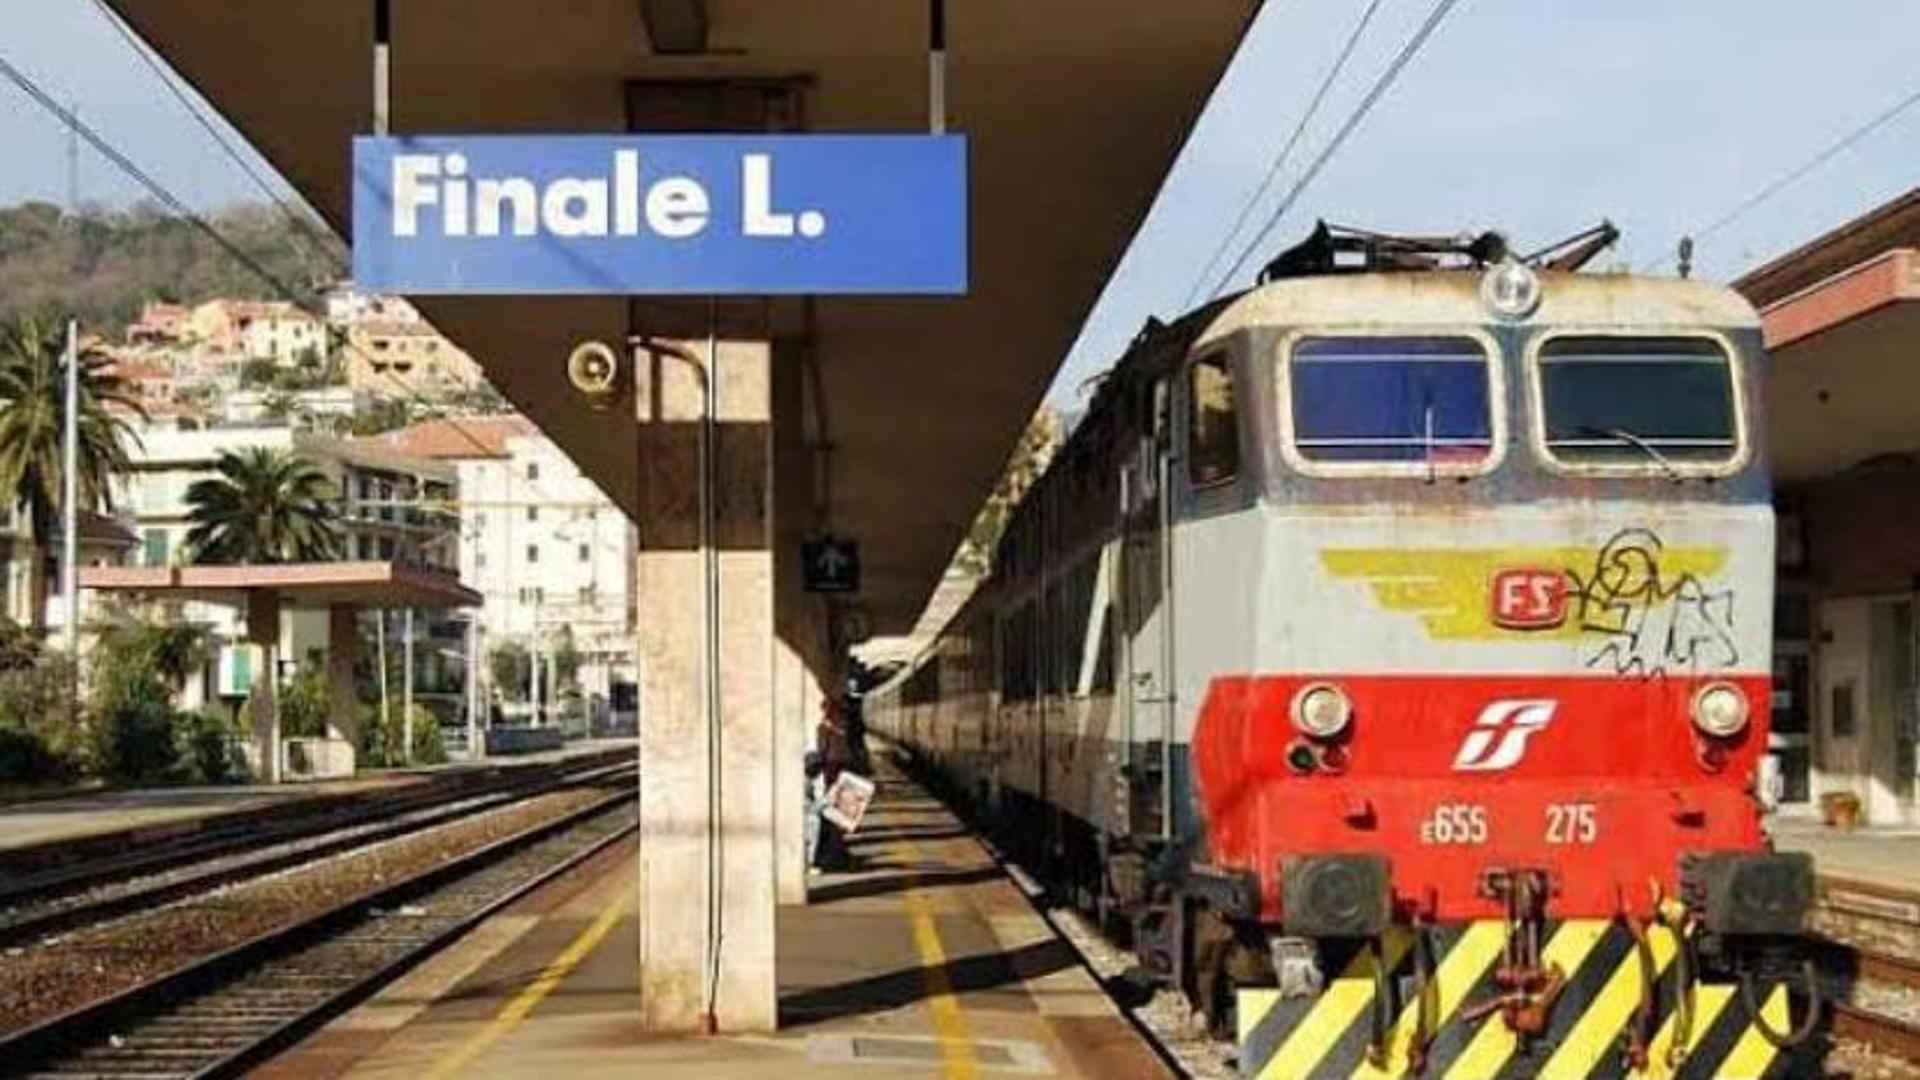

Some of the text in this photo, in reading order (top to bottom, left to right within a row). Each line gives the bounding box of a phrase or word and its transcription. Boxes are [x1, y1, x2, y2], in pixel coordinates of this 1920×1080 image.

[391, 149, 826, 237] Finale L.
[1501, 576, 1556, 616] FS
[1545, 803, 1597, 844] 275
